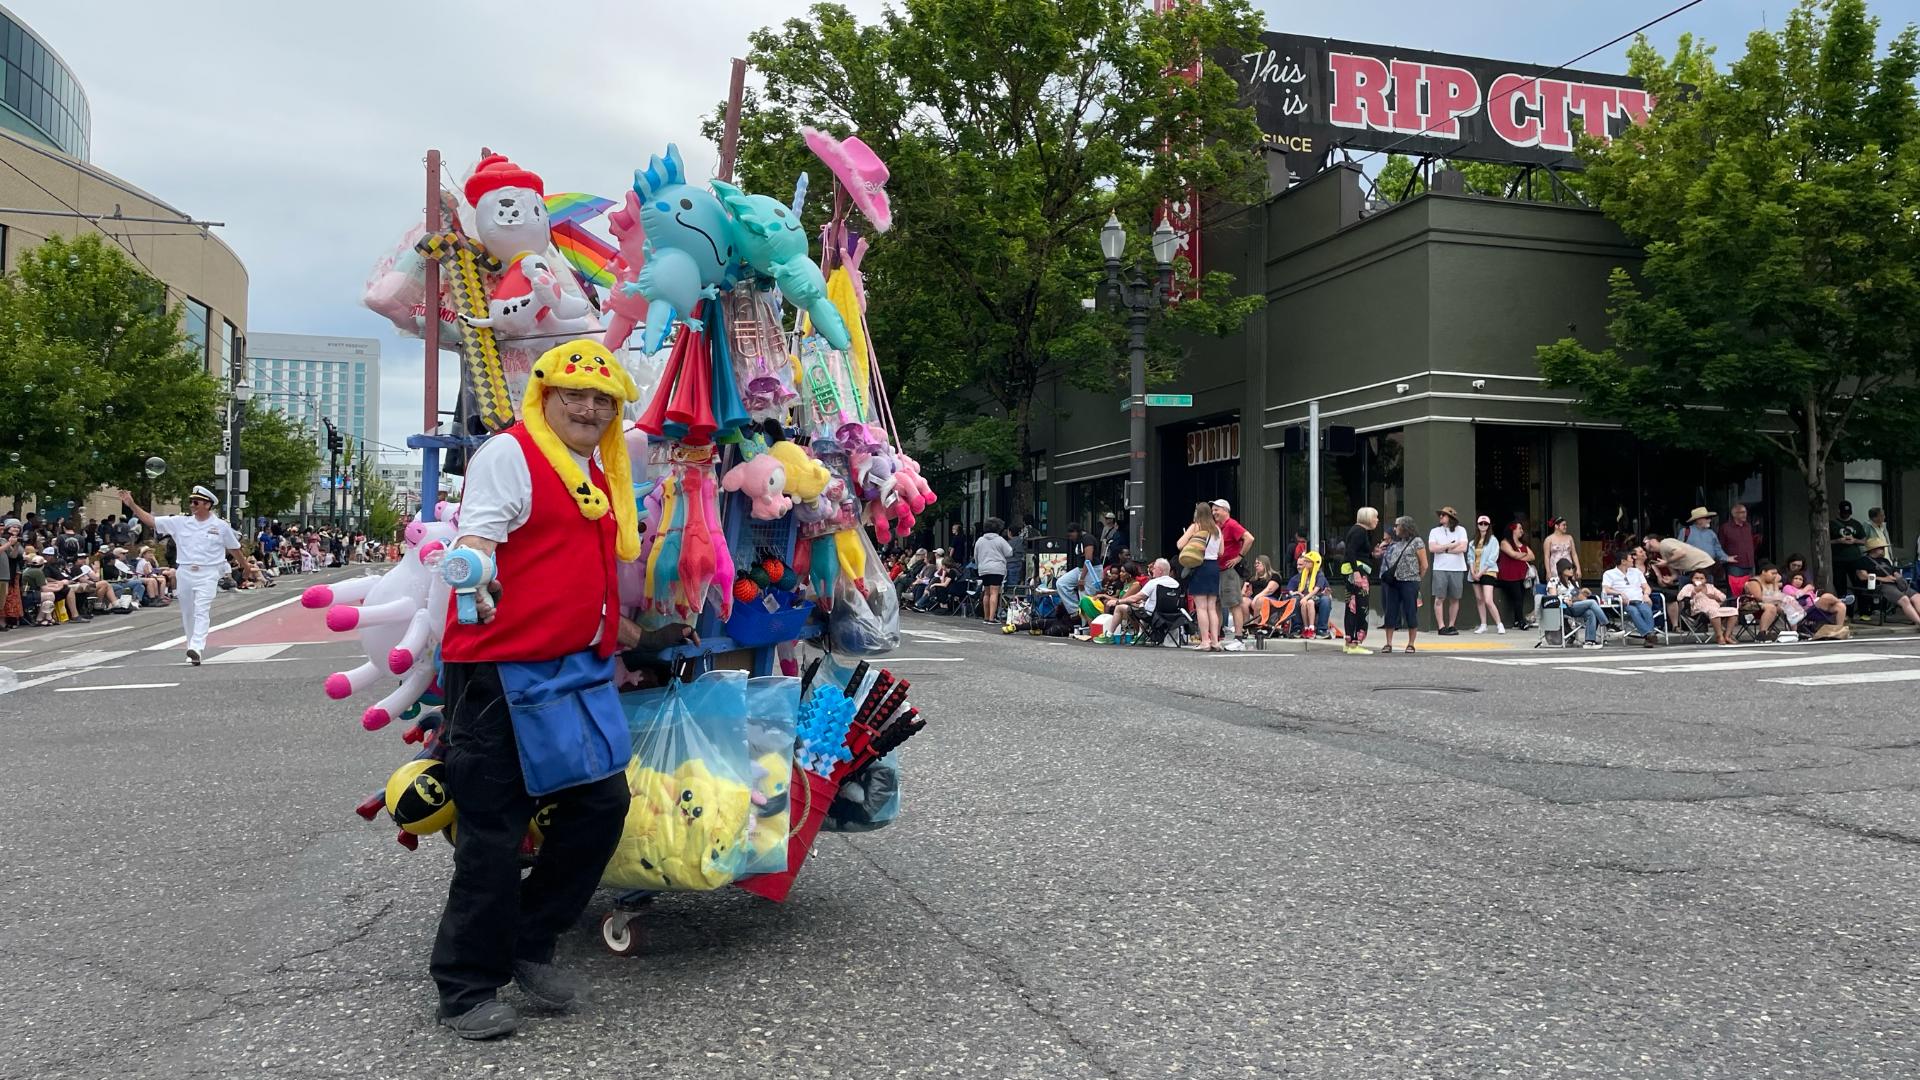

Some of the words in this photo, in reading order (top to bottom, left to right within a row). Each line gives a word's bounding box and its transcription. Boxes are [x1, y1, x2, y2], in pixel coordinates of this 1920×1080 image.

[1241, 50, 1307, 84] This
[1282, 88, 1308, 116] is
[1328, 52, 1482, 140] RIP
